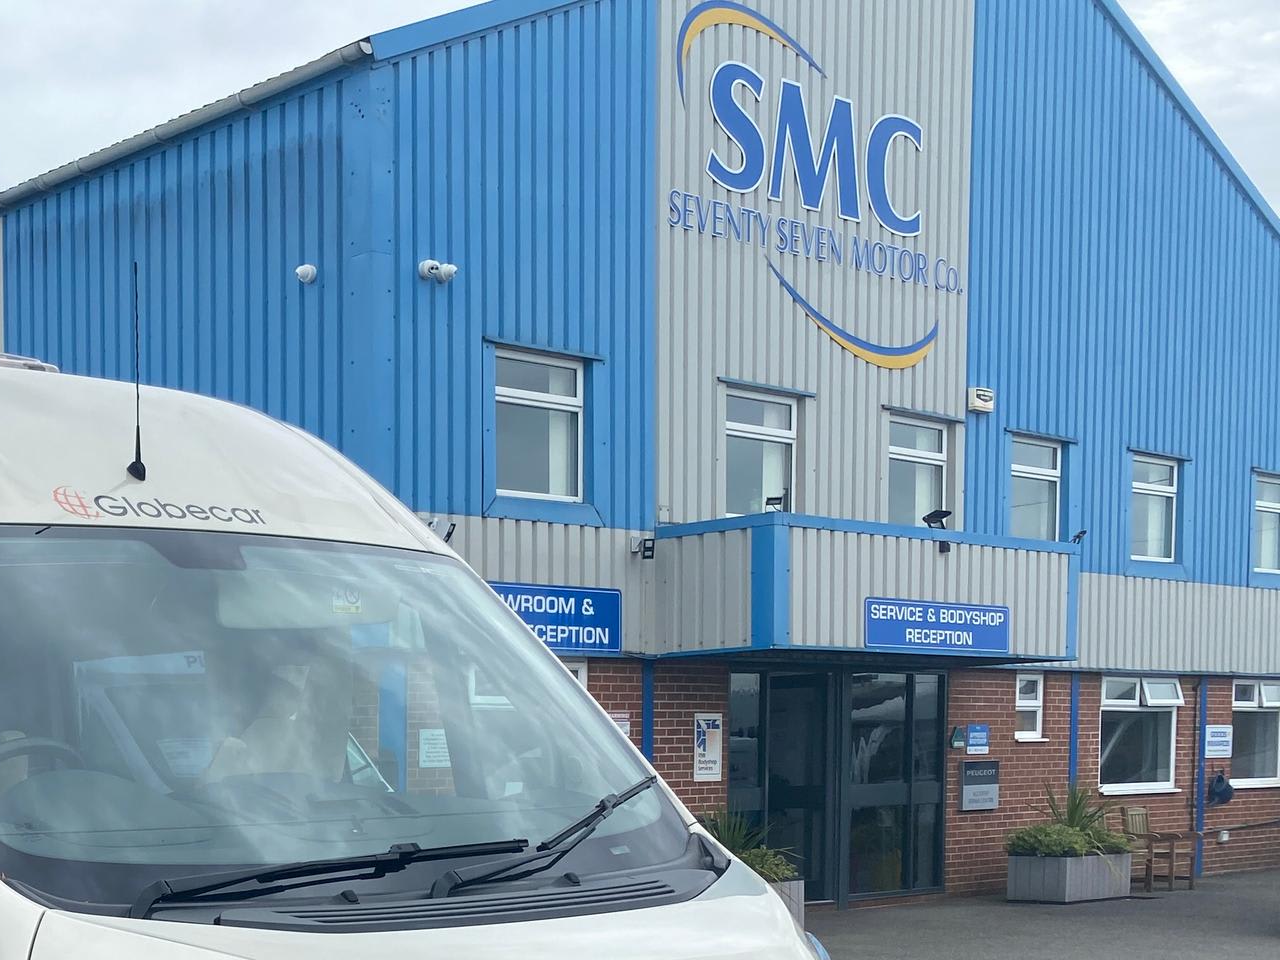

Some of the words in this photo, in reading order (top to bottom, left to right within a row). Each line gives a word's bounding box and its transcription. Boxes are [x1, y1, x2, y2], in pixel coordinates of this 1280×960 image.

[706, 61, 924, 237] SMC
[668, 189, 772, 248] SEVENTY
[775, 217, 843, 265] SEVEN
[852, 235, 928, 287] MOTOR
[93, 495, 266, 524] Globecar
[581, 598, 595, 615] &
[870, 604, 923, 622] SERVICE
[927, 608, 936, 622] &
[939, 609, 1004, 626] BODYSHOP
[905, 628, 973, 645] RECEPTION
